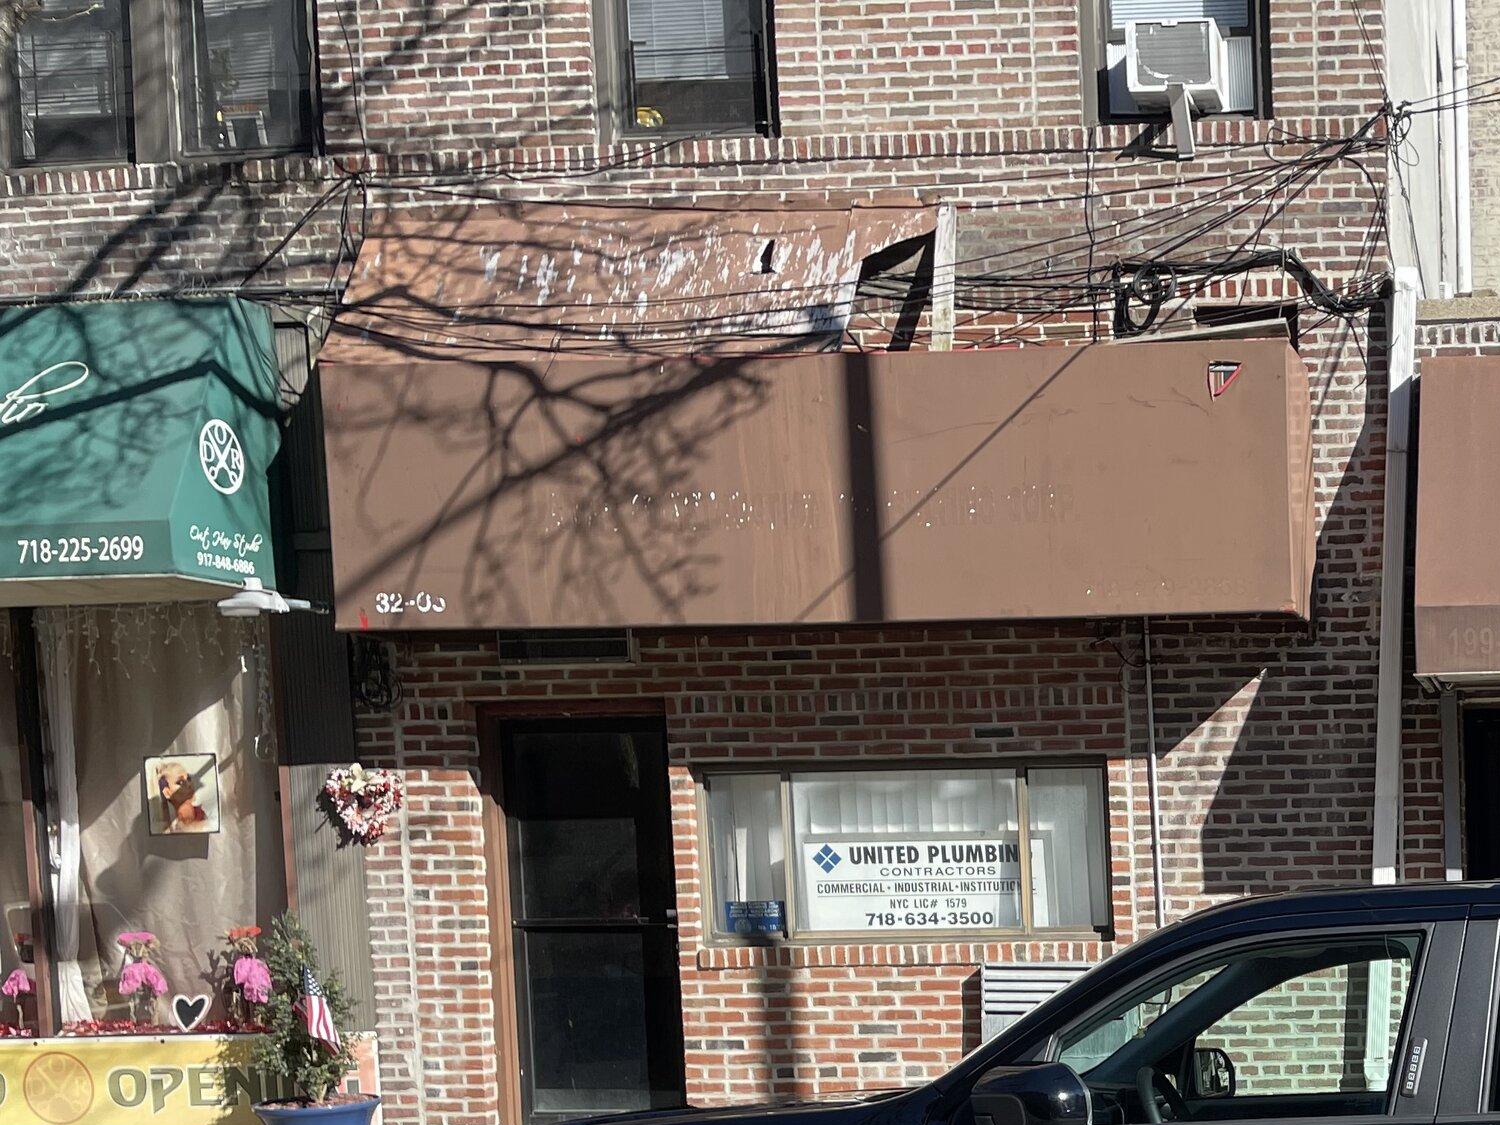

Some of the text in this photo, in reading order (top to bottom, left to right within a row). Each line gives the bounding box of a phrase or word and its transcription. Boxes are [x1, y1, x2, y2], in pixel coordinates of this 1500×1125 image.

[17, 535, 144, 564] 718-225-2699
[849, 844, 1032, 865] UNITED PLUMBIN
[879, 866, 997, 877] CONTRACTORS
[817, 880, 1035, 894] COMMERCIAL INDUSTRIAL INSTITUTIO
[889, 898, 968, 909] NYC LIC# 1579
[865, 911, 994, 926] 718-634-3500
